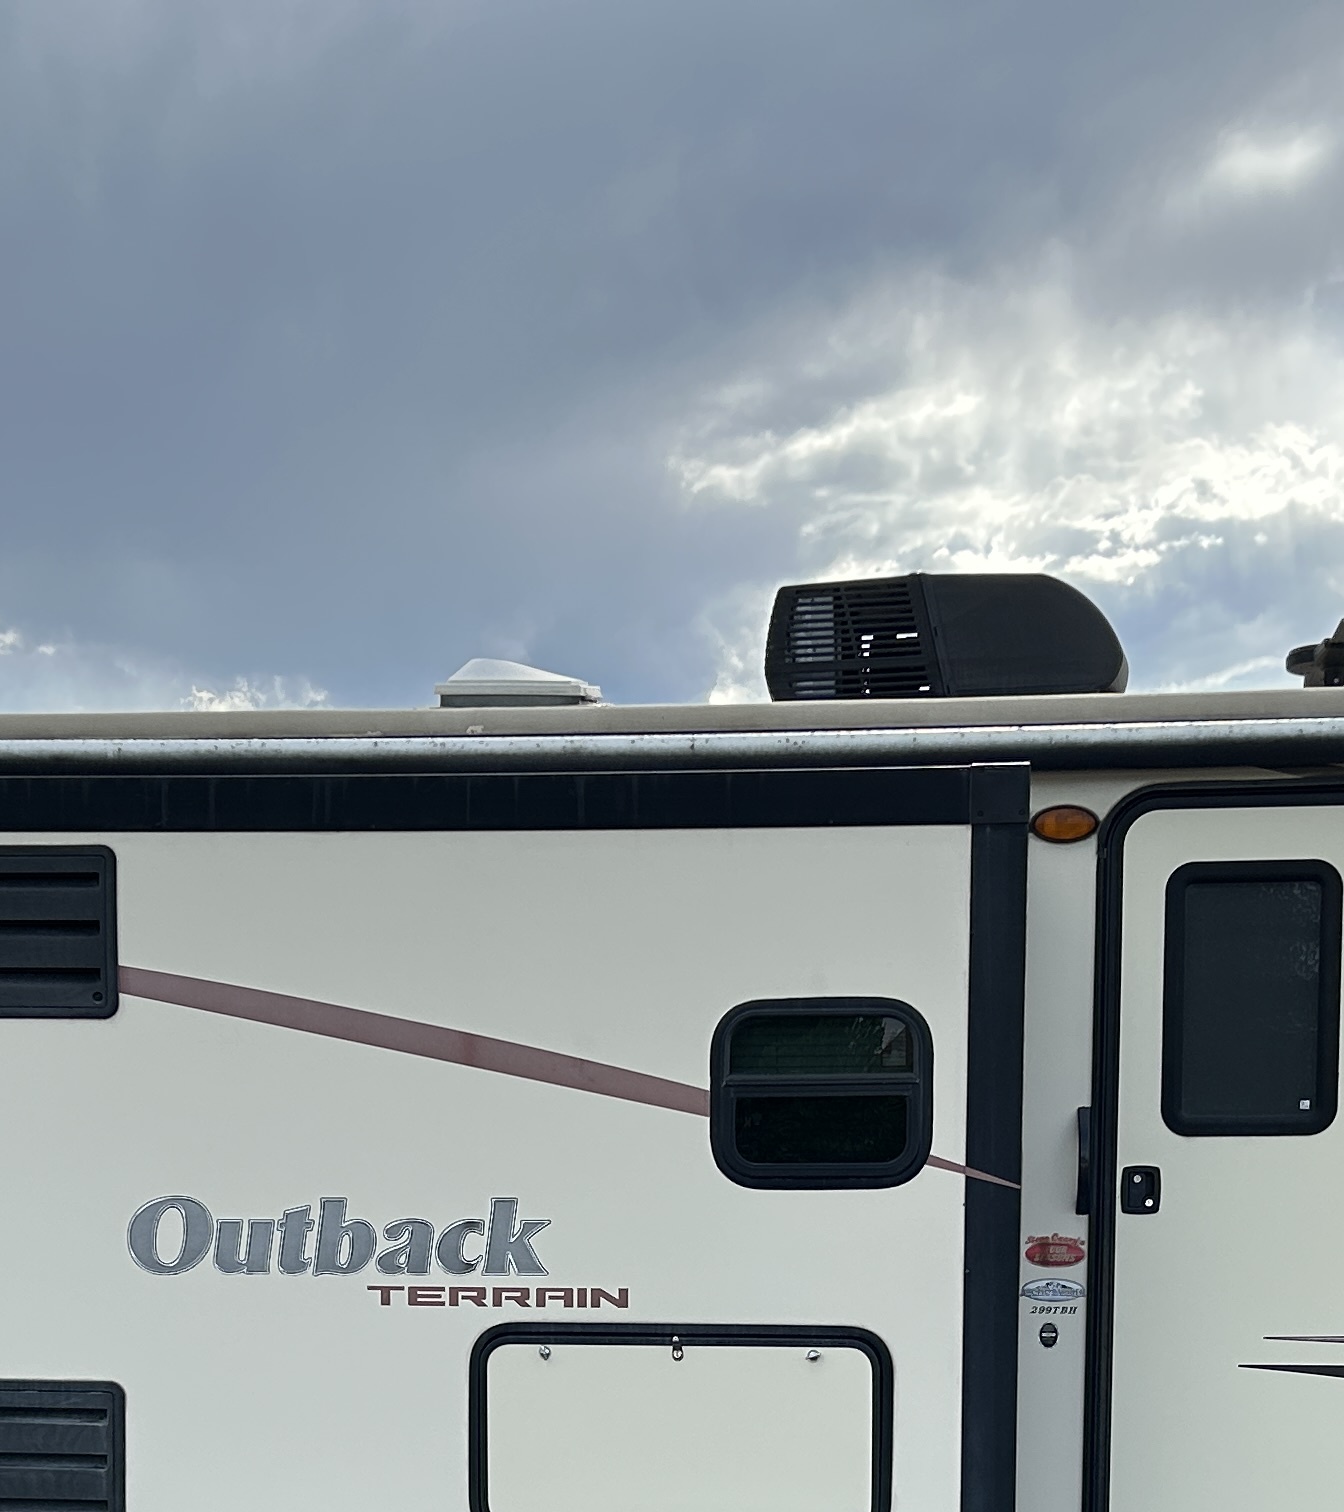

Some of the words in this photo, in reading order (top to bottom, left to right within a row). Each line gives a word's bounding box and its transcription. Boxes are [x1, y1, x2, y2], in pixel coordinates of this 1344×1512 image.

[127, 1195, 552, 1276] Outback
[367, 1285, 630, 1309] TERRAIN
[1029, 1305, 1078, 1315] 299TBH
